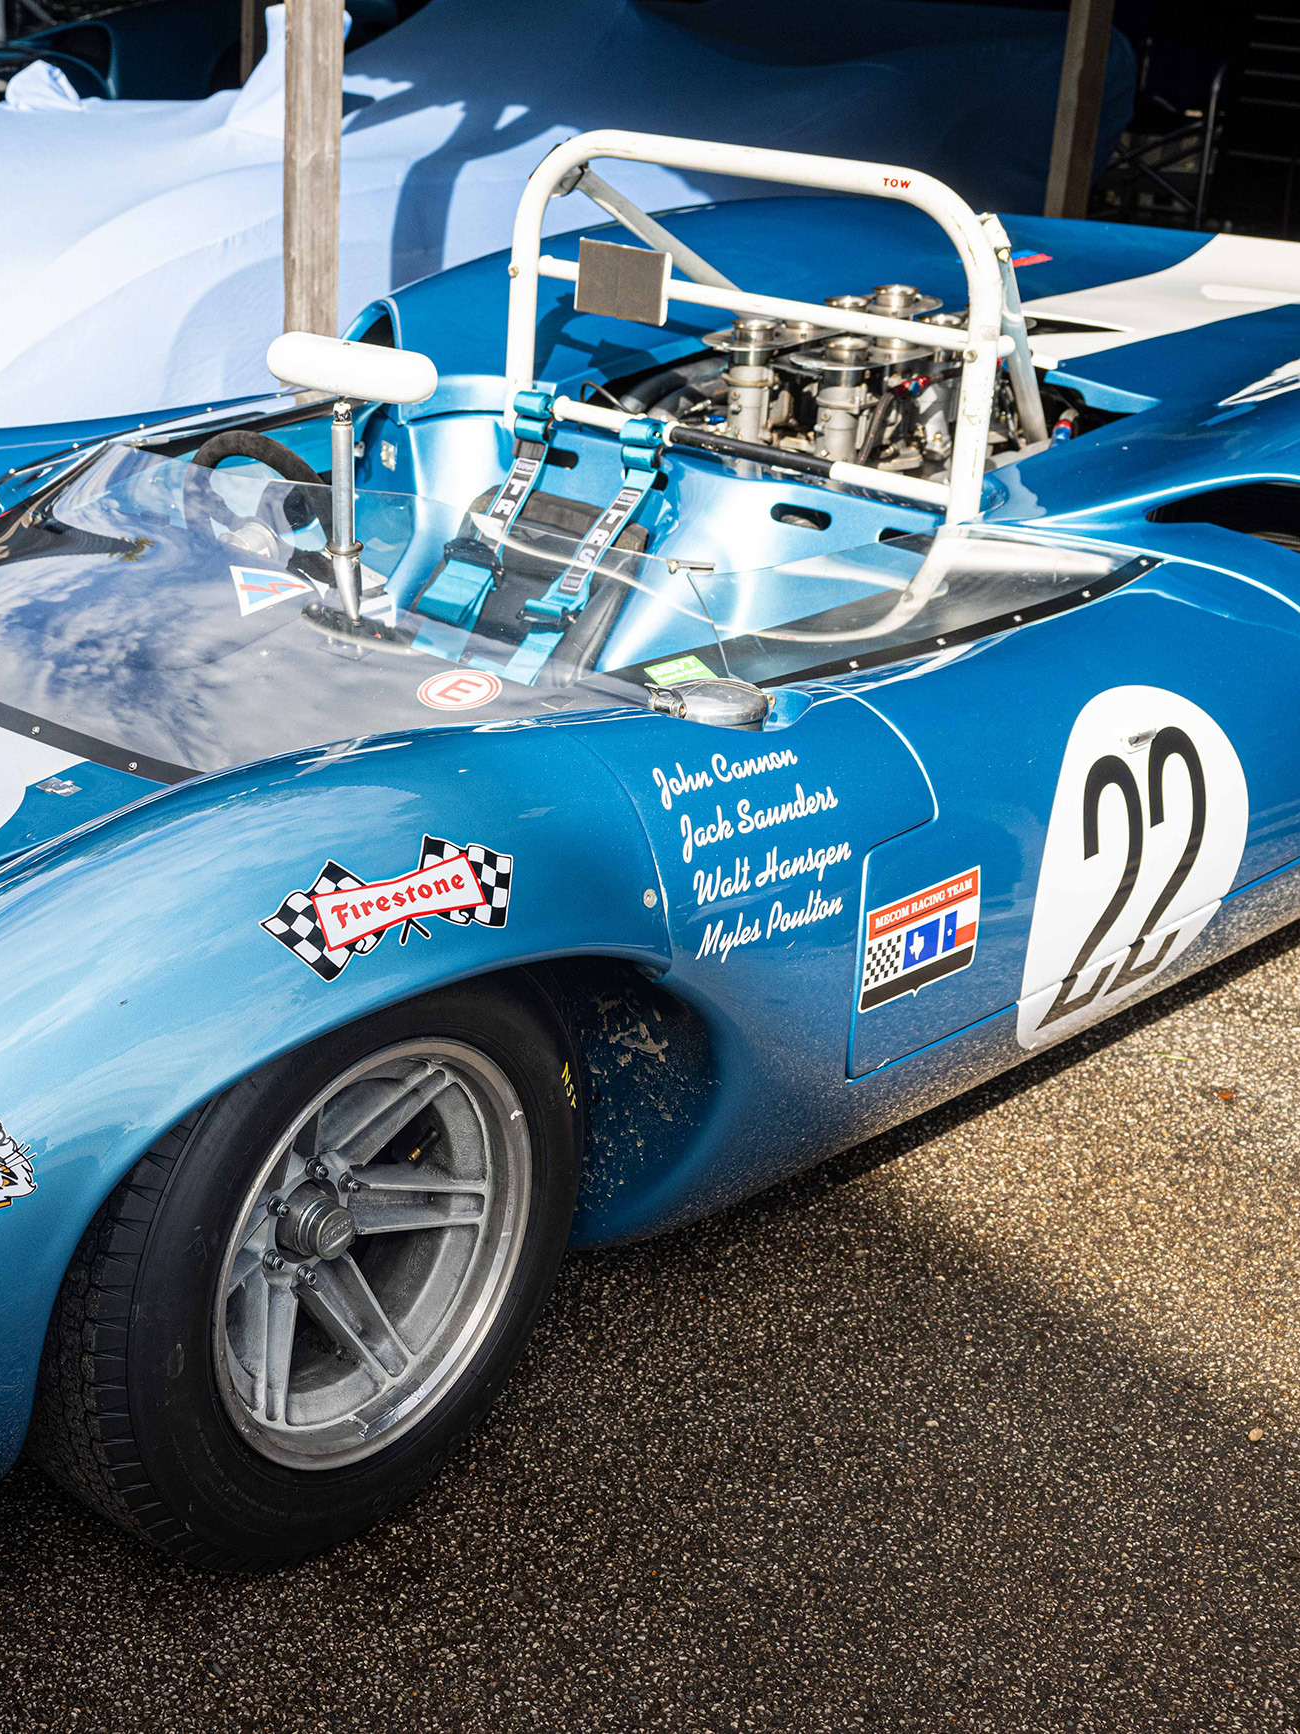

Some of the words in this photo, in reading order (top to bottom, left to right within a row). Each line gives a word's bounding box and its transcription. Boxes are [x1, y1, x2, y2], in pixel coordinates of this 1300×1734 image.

[883, 177, 912, 189] TOW
[577, 508, 626, 567] TRS
[435, 678, 484, 703] E
[652, 762, 713, 810] John
[711, 749, 798, 782] Cannon
[680, 805, 734, 863] Jack
[737, 783, 838, 834] Saunders
[331, 873, 466, 930] Firestone
[693, 856, 751, 905] Walt
[755, 841, 852, 882] Hansgen
[1034, 726, 1206, 1031] 22
[695, 912, 762, 964] Myles
[766, 889, 843, 939] Poulton
[875, 905, 910, 929] MECOM
[911, 890, 946, 914] RACING
[947, 878, 973, 898] TEAM
[561, 1061, 577, 1109] NSF
